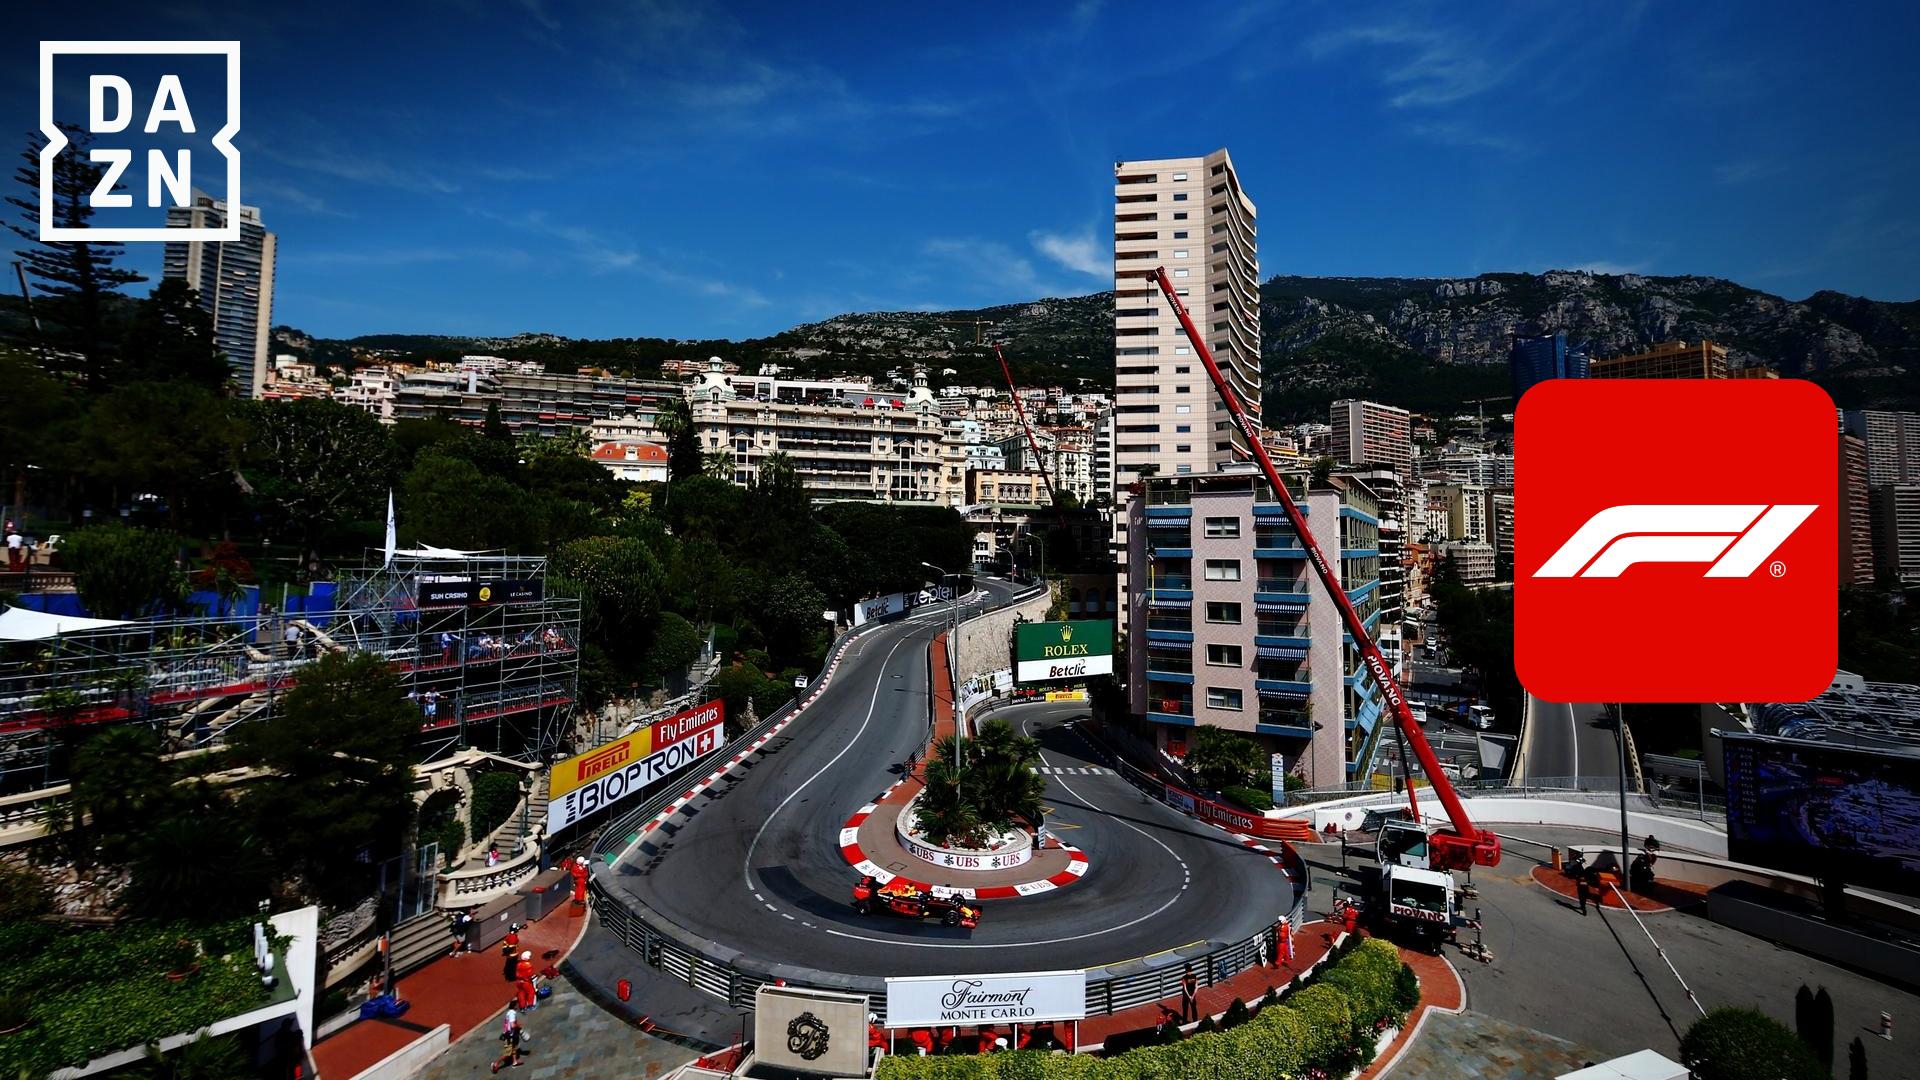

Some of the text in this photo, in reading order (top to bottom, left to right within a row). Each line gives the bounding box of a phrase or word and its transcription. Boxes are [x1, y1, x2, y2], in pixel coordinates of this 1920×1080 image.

[1236, 413, 1252, 438] PIOVANO
[1311, 547, 1328, 574] PIOVANO
[866, 597, 889, 620] Betclic
[1044, 644, 1088, 657] ROLEX
[1049, 659, 1087, 678] Betclic
[1367, 655, 1401, 706] PIOVANO
[660, 707, 718, 743] Fly Emirates
[577, 741, 630, 782] PIRELLI
[579, 737, 695, 817] BIOPTRON
[1200, 801, 1253, 829] Fly Emirates
[916, 847, 935, 861] UBS
[956, 857, 980, 868] UBS
[1003, 853, 1020, 866] UBS
[1393, 906, 1446, 922] PIOVANO
[941, 979, 1033, 1010] Fairmont
[940, 1006, 1035, 1021] MONTE CARLO
